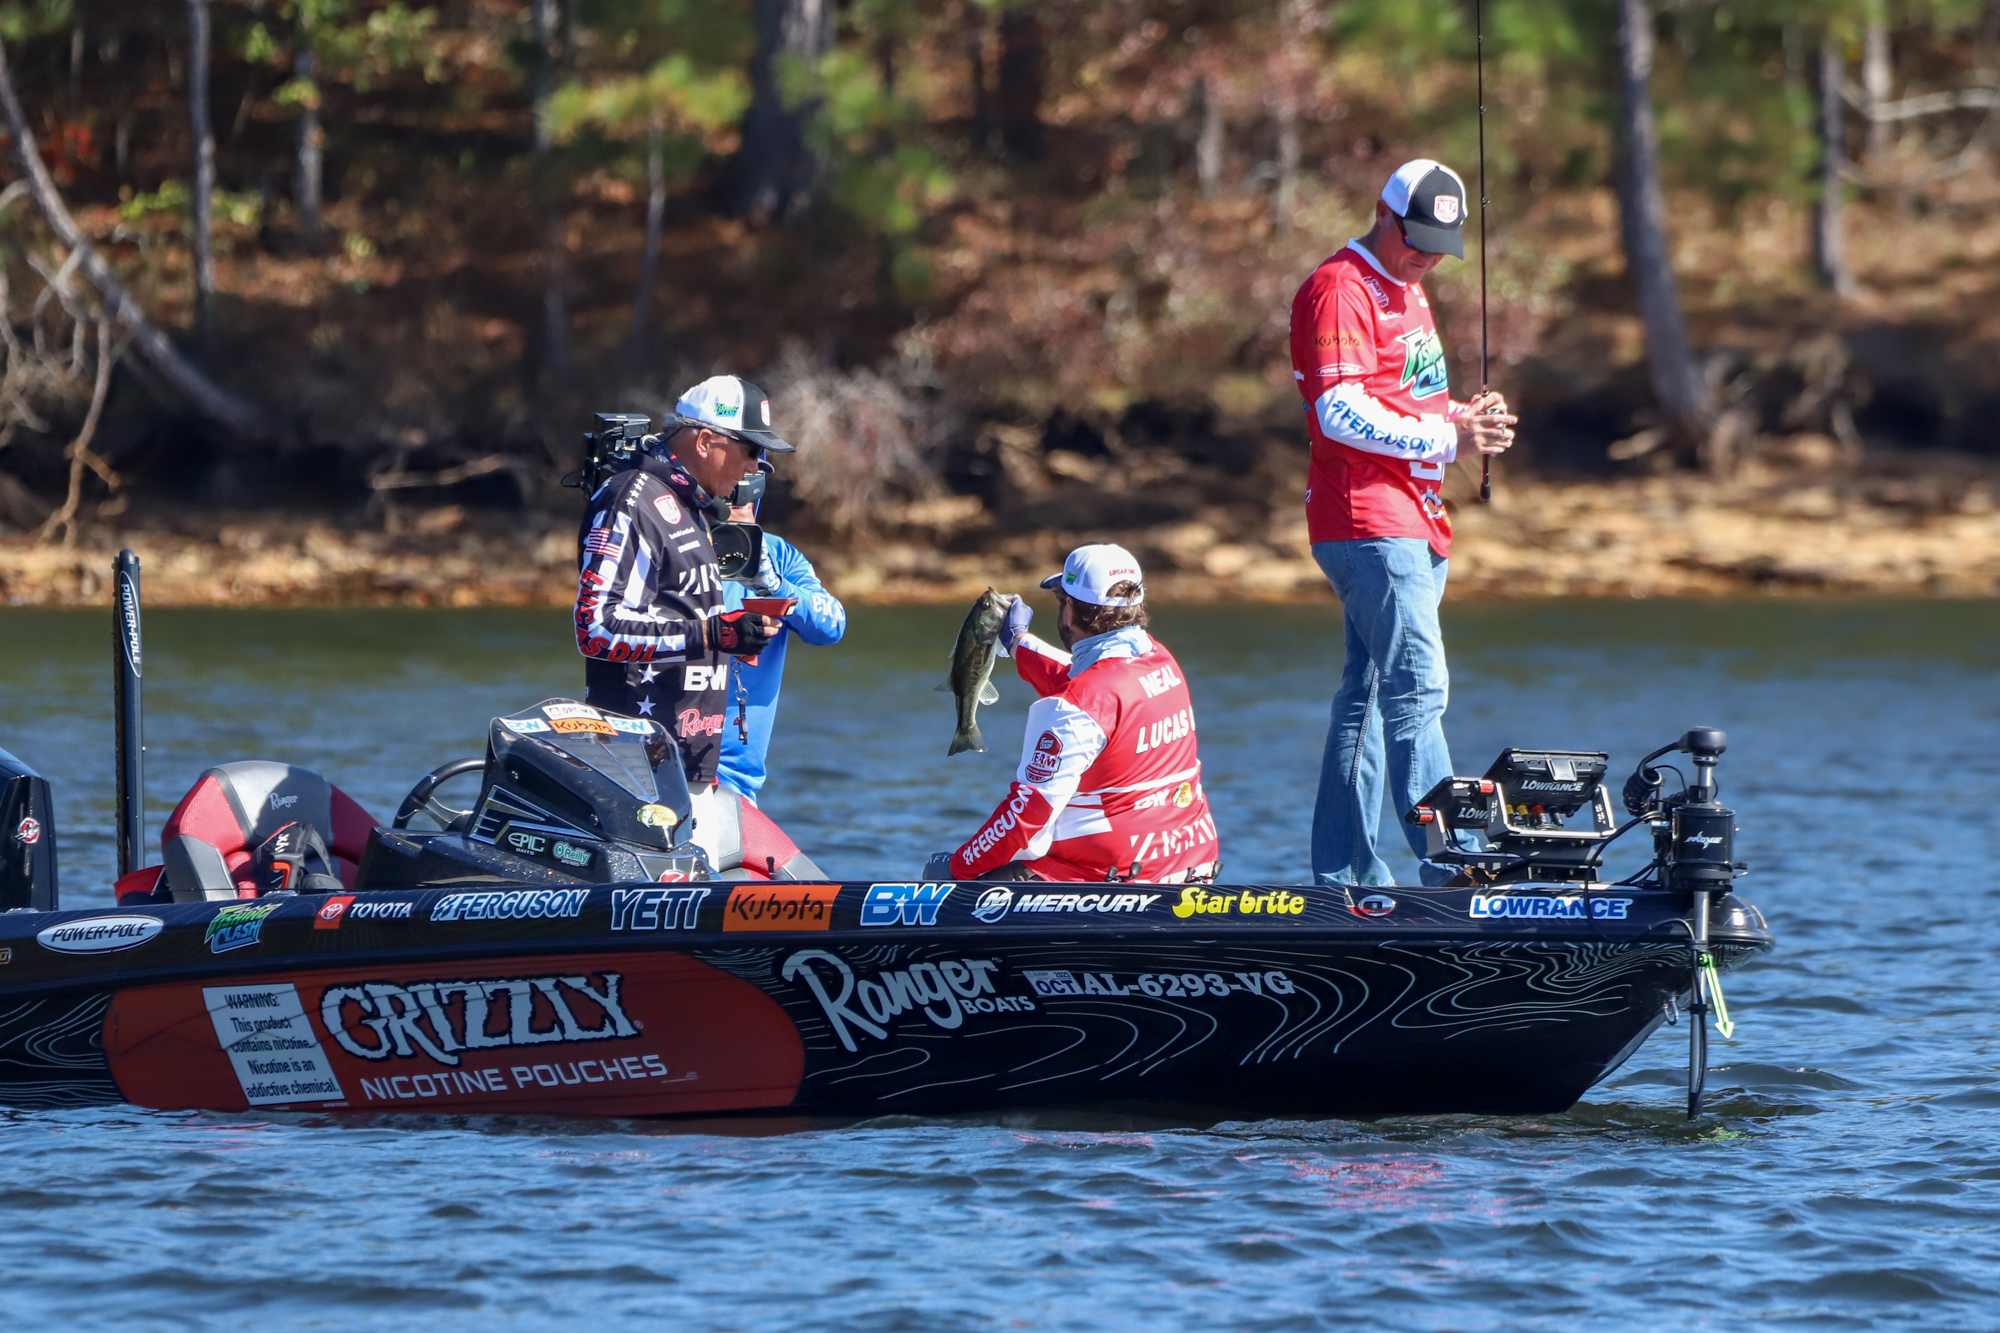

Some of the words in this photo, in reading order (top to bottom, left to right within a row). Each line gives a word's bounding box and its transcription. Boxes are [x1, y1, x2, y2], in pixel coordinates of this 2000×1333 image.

[1315, 333, 1359, 348] Kubota
[1340, 406, 1435, 453] FERGUSON
[120, 583, 141, 665] POWER-POLE
[575, 568, 609, 656] LUCAS
[606, 641, 658, 662] OIL
[1138, 664, 1181, 699] NEAL
[554, 719, 613, 734] Kubota
[1135, 710, 1188, 755] LUCAS
[1521, 779, 1585, 792] LOWRANCE
[268, 792, 298, 811] Ranger
[971, 783, 1034, 858] FERGUON
[508, 832, 546, 852] EPIC
[553, 841, 591, 865] O'Reilly
[350, 902, 413, 919] TOYOTA
[451, 889, 590, 921] FERGUSON
[611, 888, 708, 930] YETI
[730, 893, 825, 922] Kubota
[1013, 893, 1162, 913] MERCURY
[1173, 887, 1237, 918] Star
[1239, 889, 1305, 916] brite
[1471, 896, 1631, 919] LOWRANCE
[51, 922, 148, 942] POWER-POLE
[206, 904, 278, 938] FISHING
[213, 920, 262, 952] CLASH
[1035, 979, 1077, 995] OCT
[1082, 971, 1297, 998] AL-6293-VG
[224, 993, 280, 1010] WARNING:
[782, 949, 999, 1052] Ranger
[960, 995, 1036, 1015] BOATS
[230, 1016, 254, 1033] This
[254, 1015, 293, 1032] product
[320, 973, 638, 1066] GRIZZLY
[231, 1037, 273, 1053] contains
[247, 1058, 291, 1075] Nicotine
[290, 1057, 302, 1073] is
[303, 1060, 316, 1072] an
[359, 1067, 507, 1101] NICOTINE
[511, 1054, 669, 1089] POUCHES
[245, 1081, 291, 1098] addictive
[291, 1078, 340, 1096] chemical.
